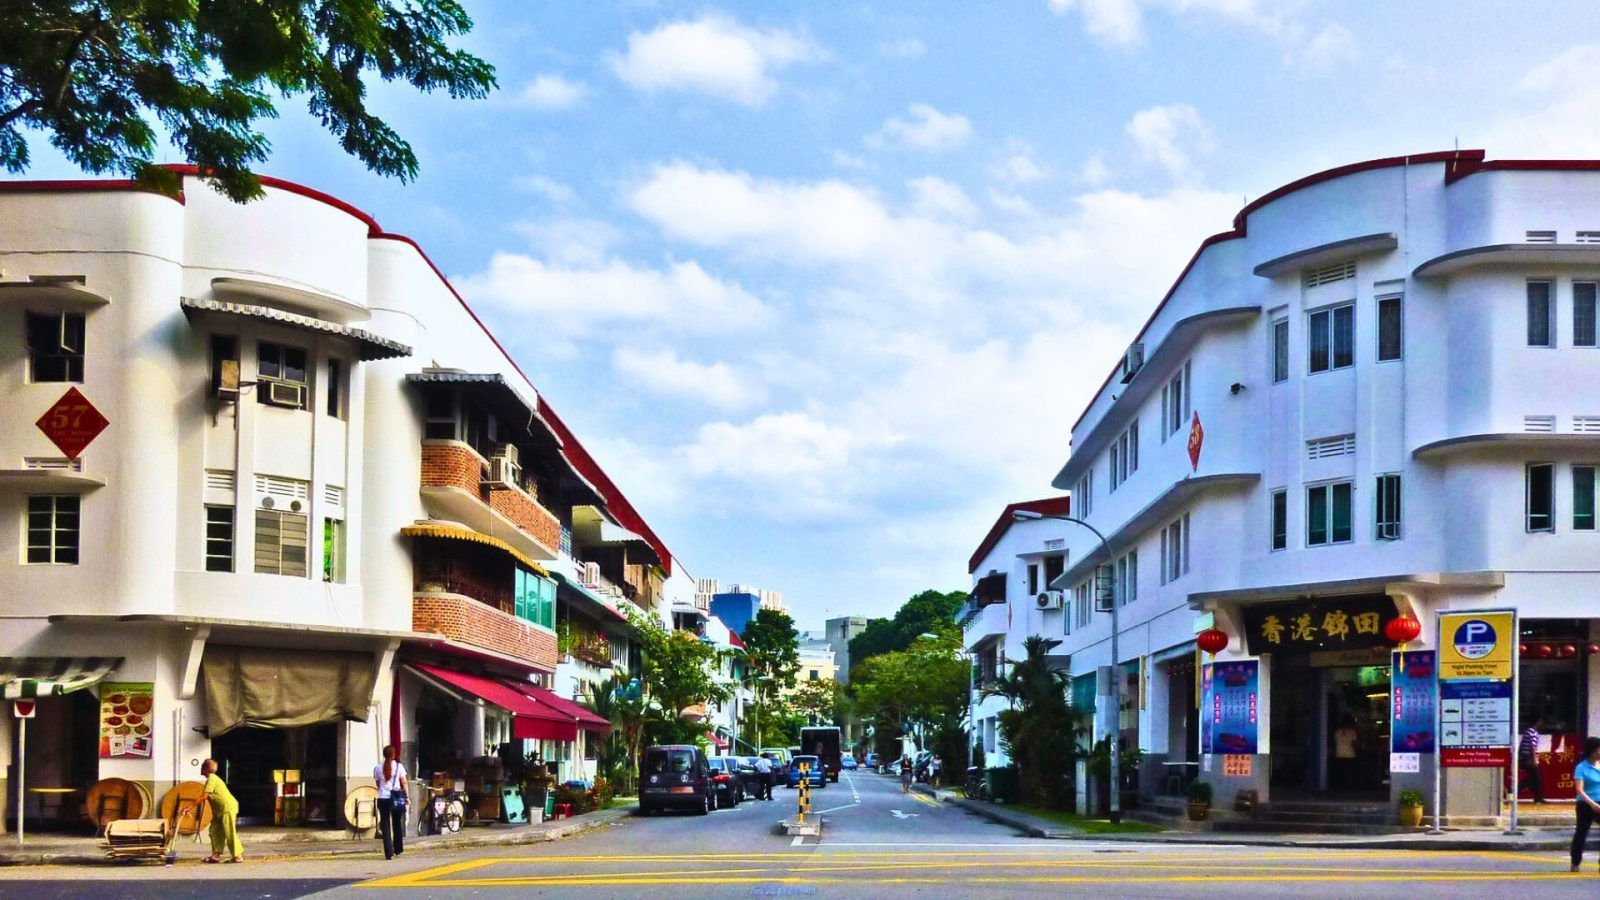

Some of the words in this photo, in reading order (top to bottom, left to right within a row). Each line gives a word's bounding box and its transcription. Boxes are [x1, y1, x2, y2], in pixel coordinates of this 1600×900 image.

[51, 405, 89, 429] 57
[1261, 609, 1379, 644] 香港錦田
[1466, 623, 1488, 643] P
